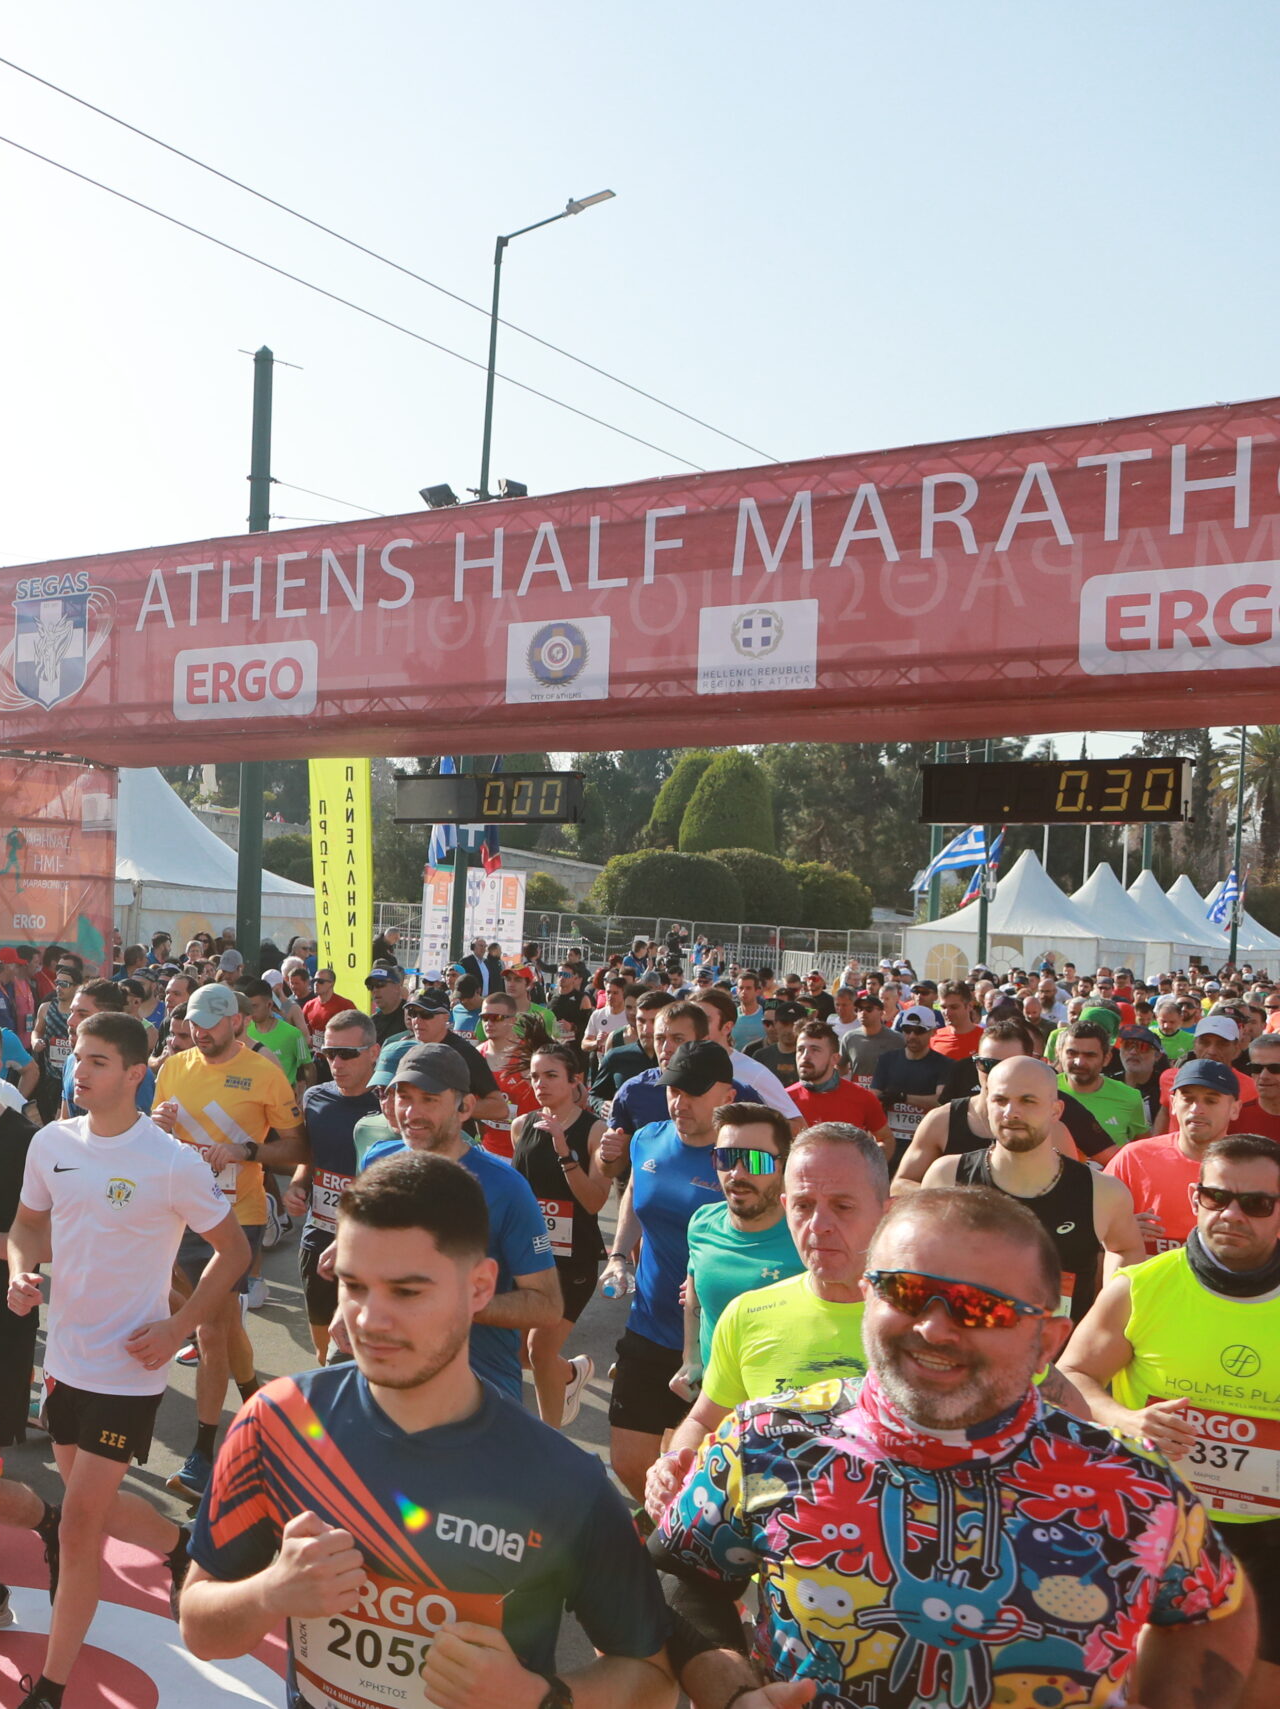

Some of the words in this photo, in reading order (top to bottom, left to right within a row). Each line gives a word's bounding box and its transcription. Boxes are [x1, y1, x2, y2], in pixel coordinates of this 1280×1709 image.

[135, 537, 416, 632] ATHENS
[453, 504, 687, 603] HALF
[731, 435, 1280, 577] MARATH
[15, 572, 90, 600] SEGAS
[1105, 583, 1280, 653] ERG
[185, 656, 304, 705] ERGO
[702, 668, 754, 680] HELLENIC
[757, 664, 811, 676] REPUBLIC
[702, 679, 745, 689] REGION
[750, 677, 764, 687] OF
[769, 675, 811, 686] ATTICA
[530, 693, 545, 701] CITY
[482, 779, 562, 816] 0.00
[1055, 768, 1175, 813] 0.30
[12, 913, 46, 929] ERGO
[55, 1038, 71, 1047] ERG
[322, 1172, 353, 1191] ERG
[322, 1190, 341, 1208] 22
[1165, 1376, 1245, 1399] HOLMES
[1181, 1440, 1250, 1473] 337
[346, 1577, 457, 1633] RGO
[300, 1621, 308, 1659] BLOCK
[326, 1617, 433, 1679] 205
[358, 1678, 408, 1700] ΧΡΗΣΤΟΣ
